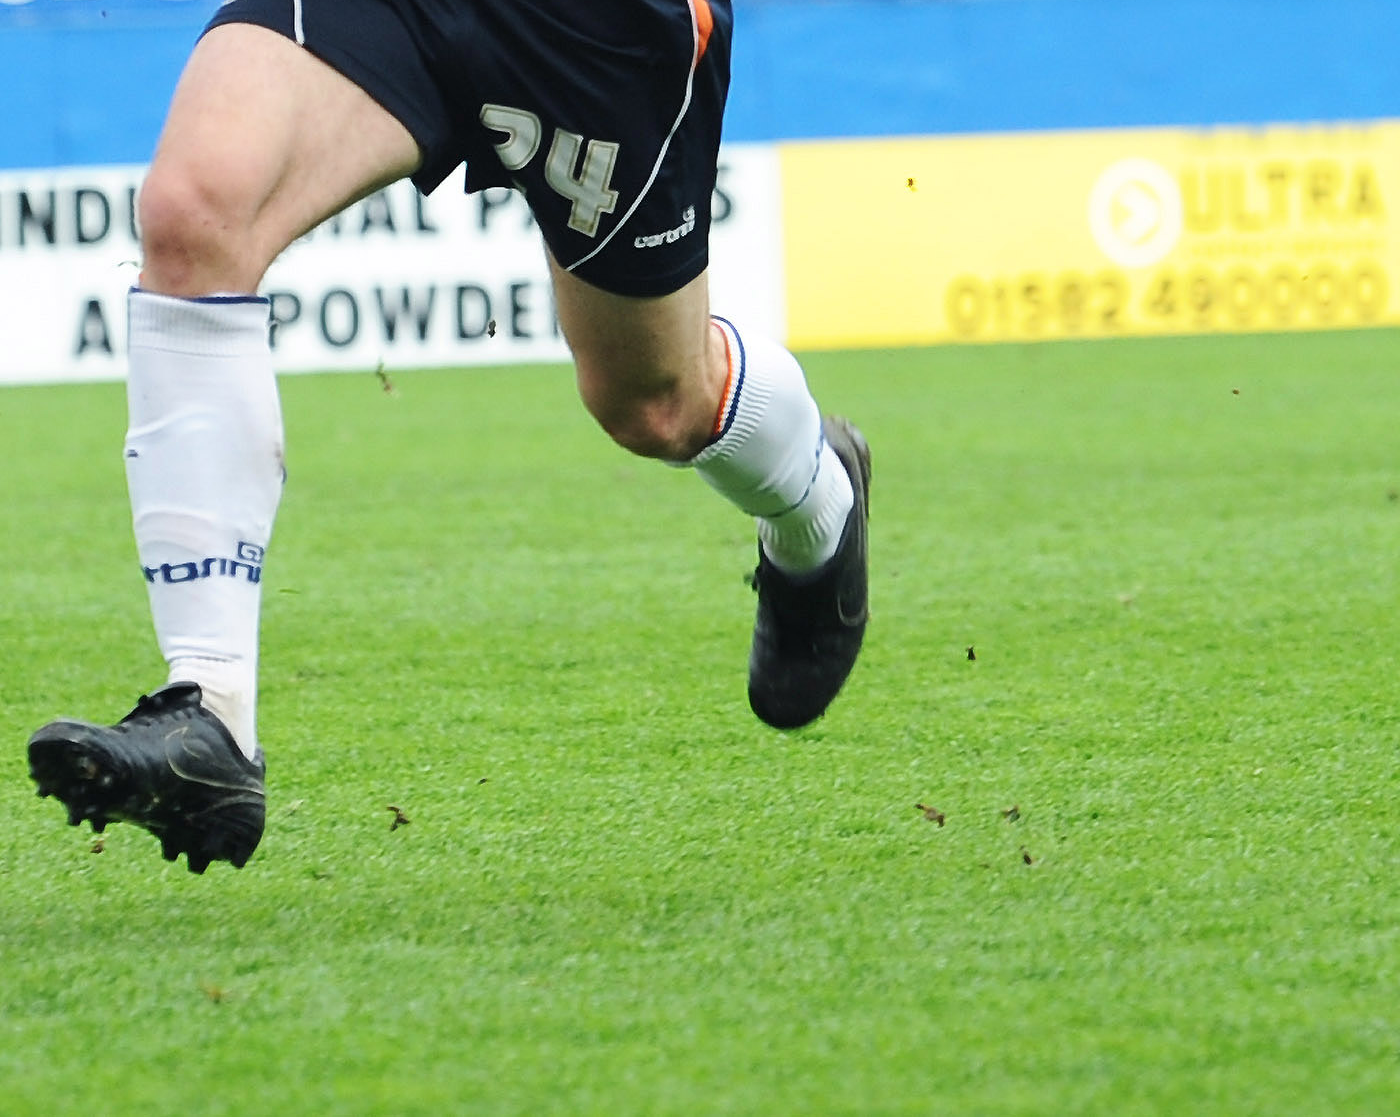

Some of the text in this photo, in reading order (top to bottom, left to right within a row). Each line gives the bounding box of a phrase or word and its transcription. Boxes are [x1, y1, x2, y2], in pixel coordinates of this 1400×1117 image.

[1183, 160, 1387, 233] ULTRA
[268, 284, 560, 348] POWDE
[946, 273, 1131, 337] 01582
